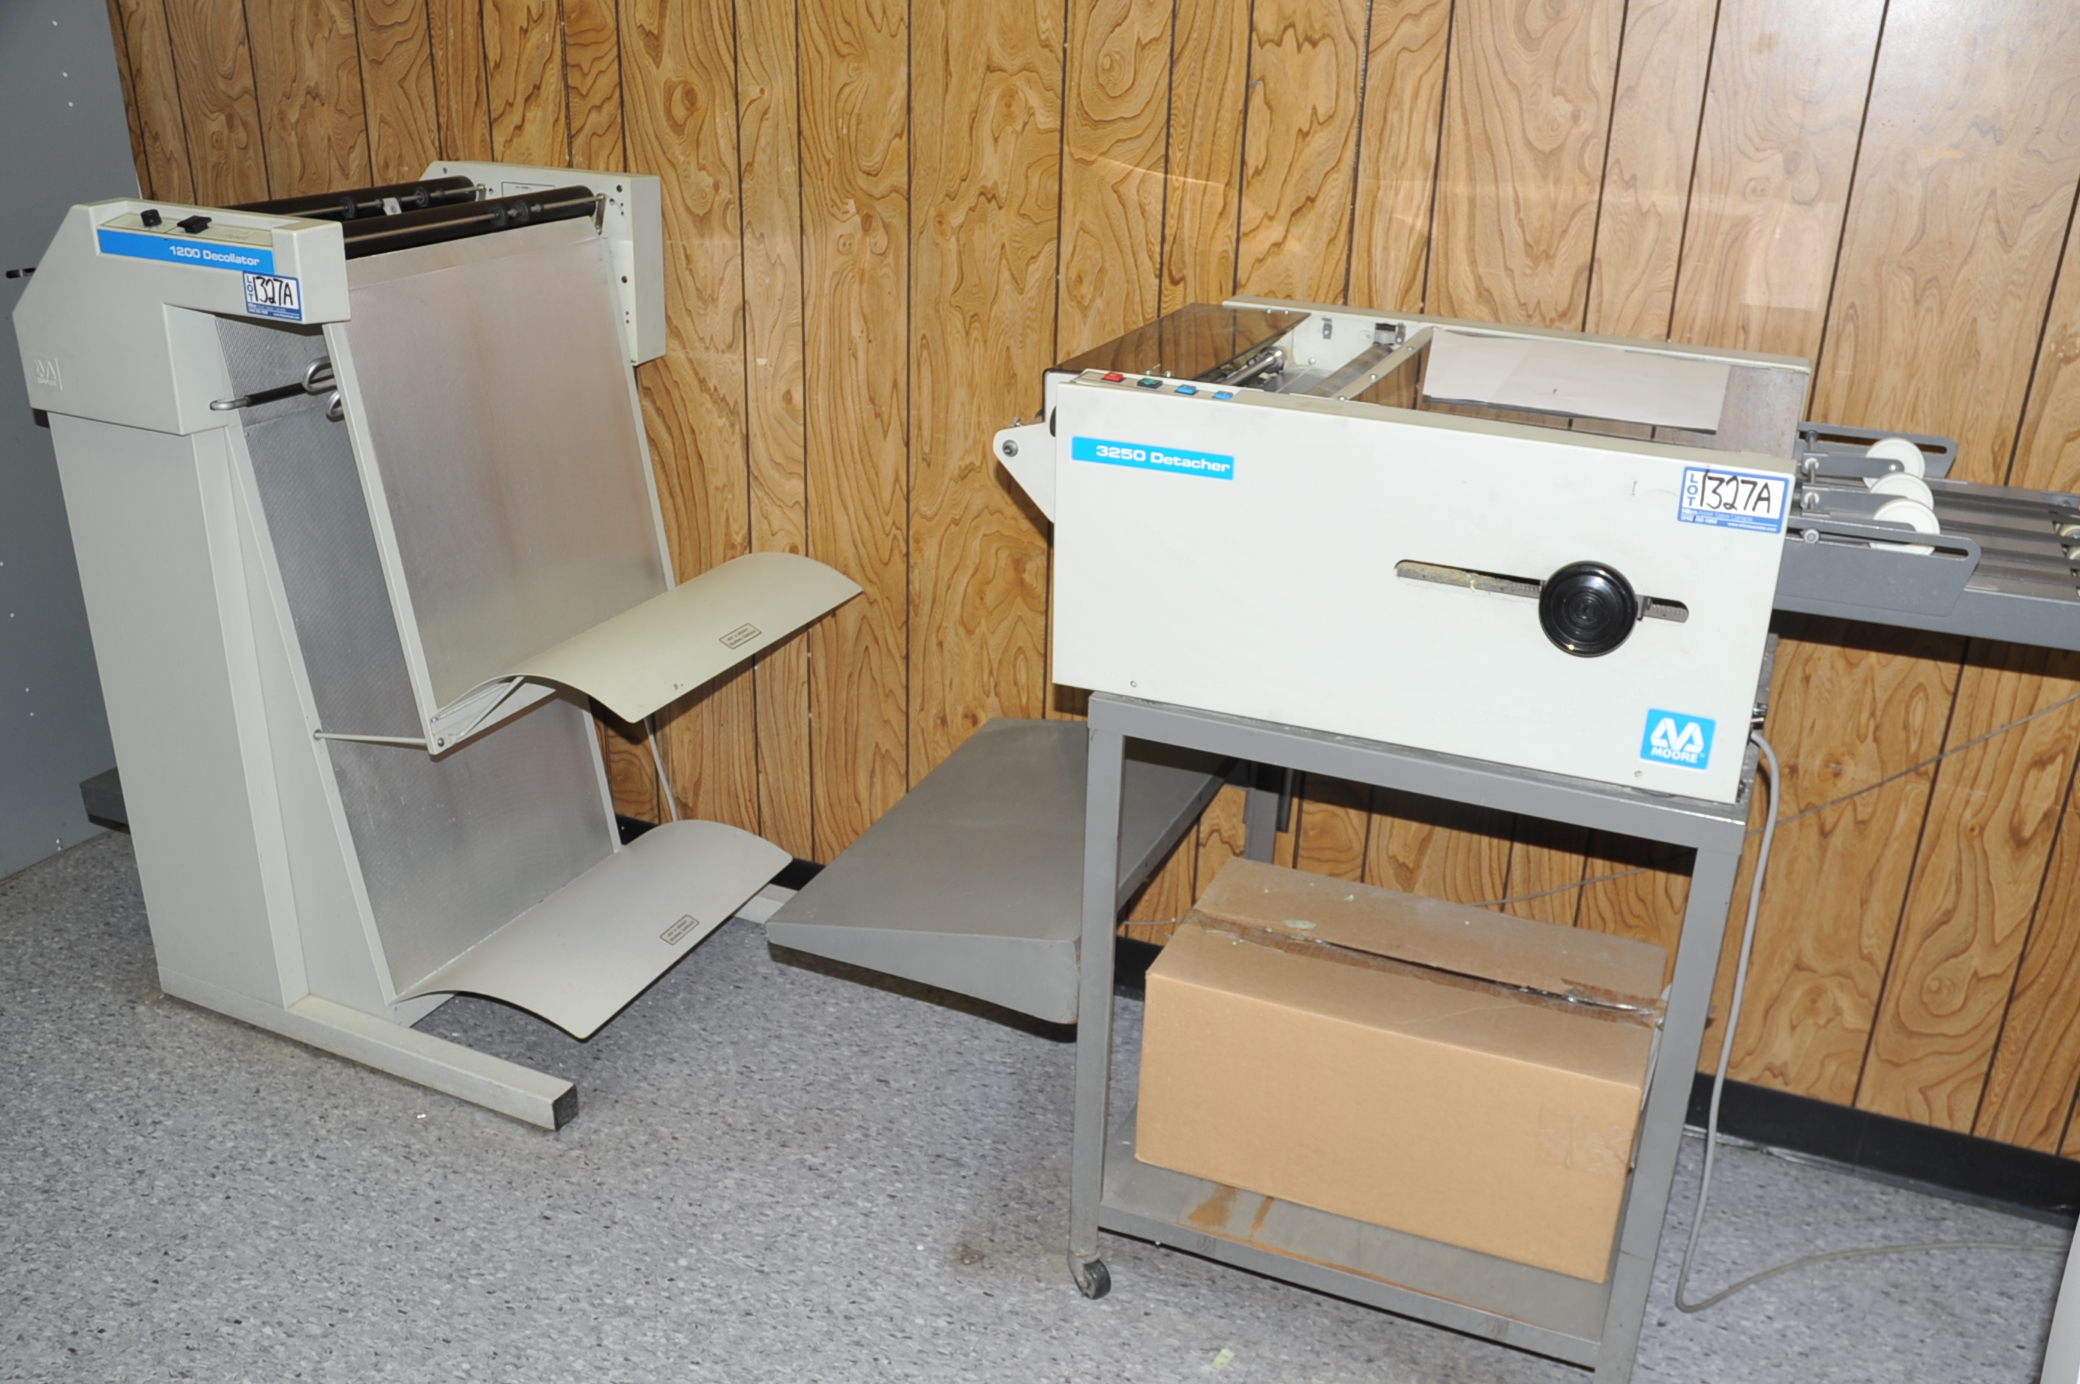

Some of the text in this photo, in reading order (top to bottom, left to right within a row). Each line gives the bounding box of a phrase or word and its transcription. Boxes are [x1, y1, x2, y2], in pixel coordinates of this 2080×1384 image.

[169, 245, 260, 266] 1200 Decollator
[246, 275, 254, 302] LOT
[252, 275, 294, 307] 1327A
[1096, 445, 1231, 473] 3250 Detacher
[1686, 473, 1699, 507] LOT
[1699, 469, 1771, 514] 1327A
[1650, 746, 1699, 764] MOORE
